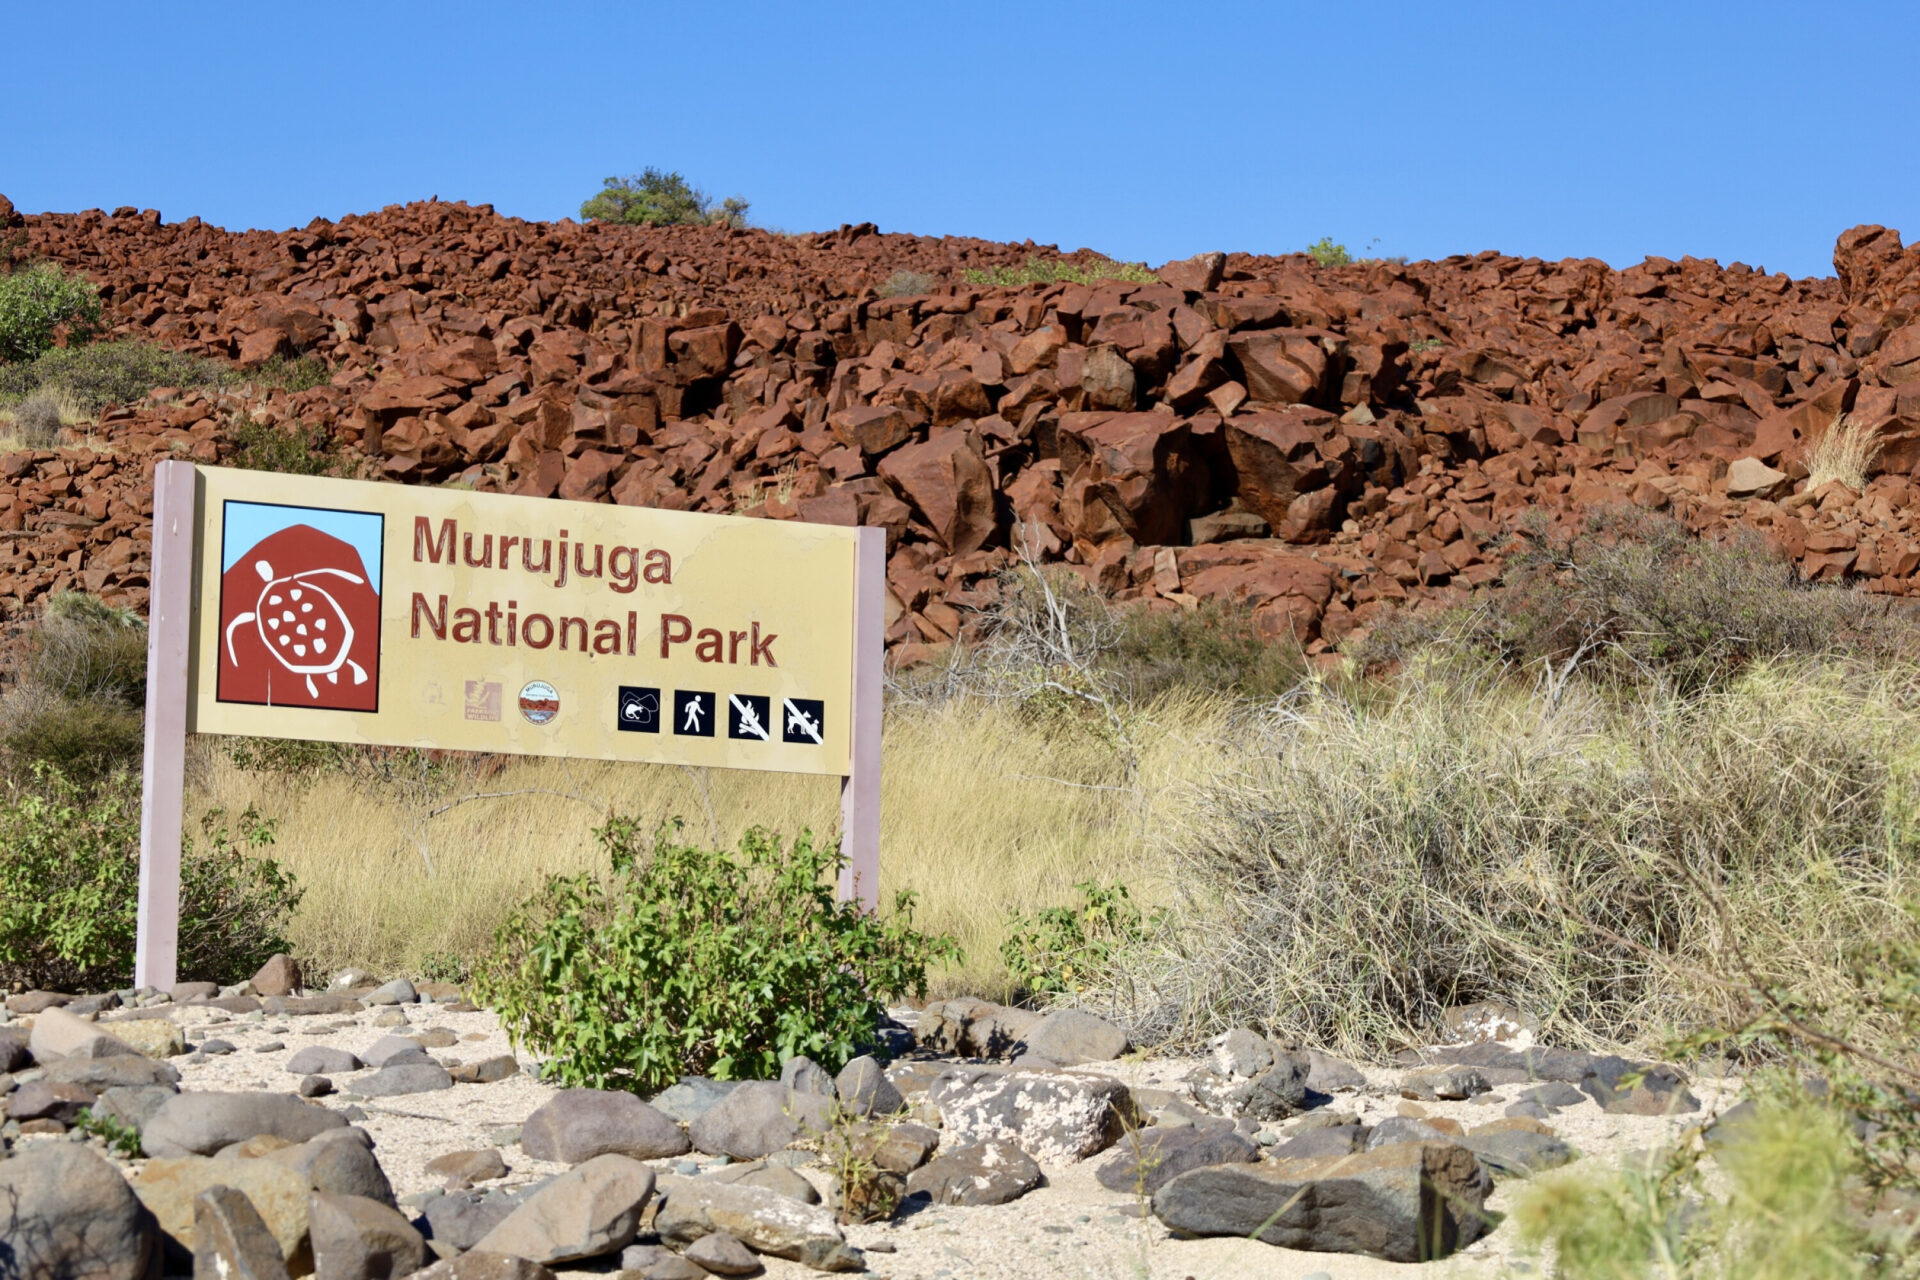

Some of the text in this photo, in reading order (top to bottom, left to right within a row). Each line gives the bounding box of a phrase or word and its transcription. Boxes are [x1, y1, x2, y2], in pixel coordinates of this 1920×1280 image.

[413, 515, 673, 594] Murujuga
[410, 591, 779, 668] National Park
[525, 683, 554, 695] MURUJUGA
